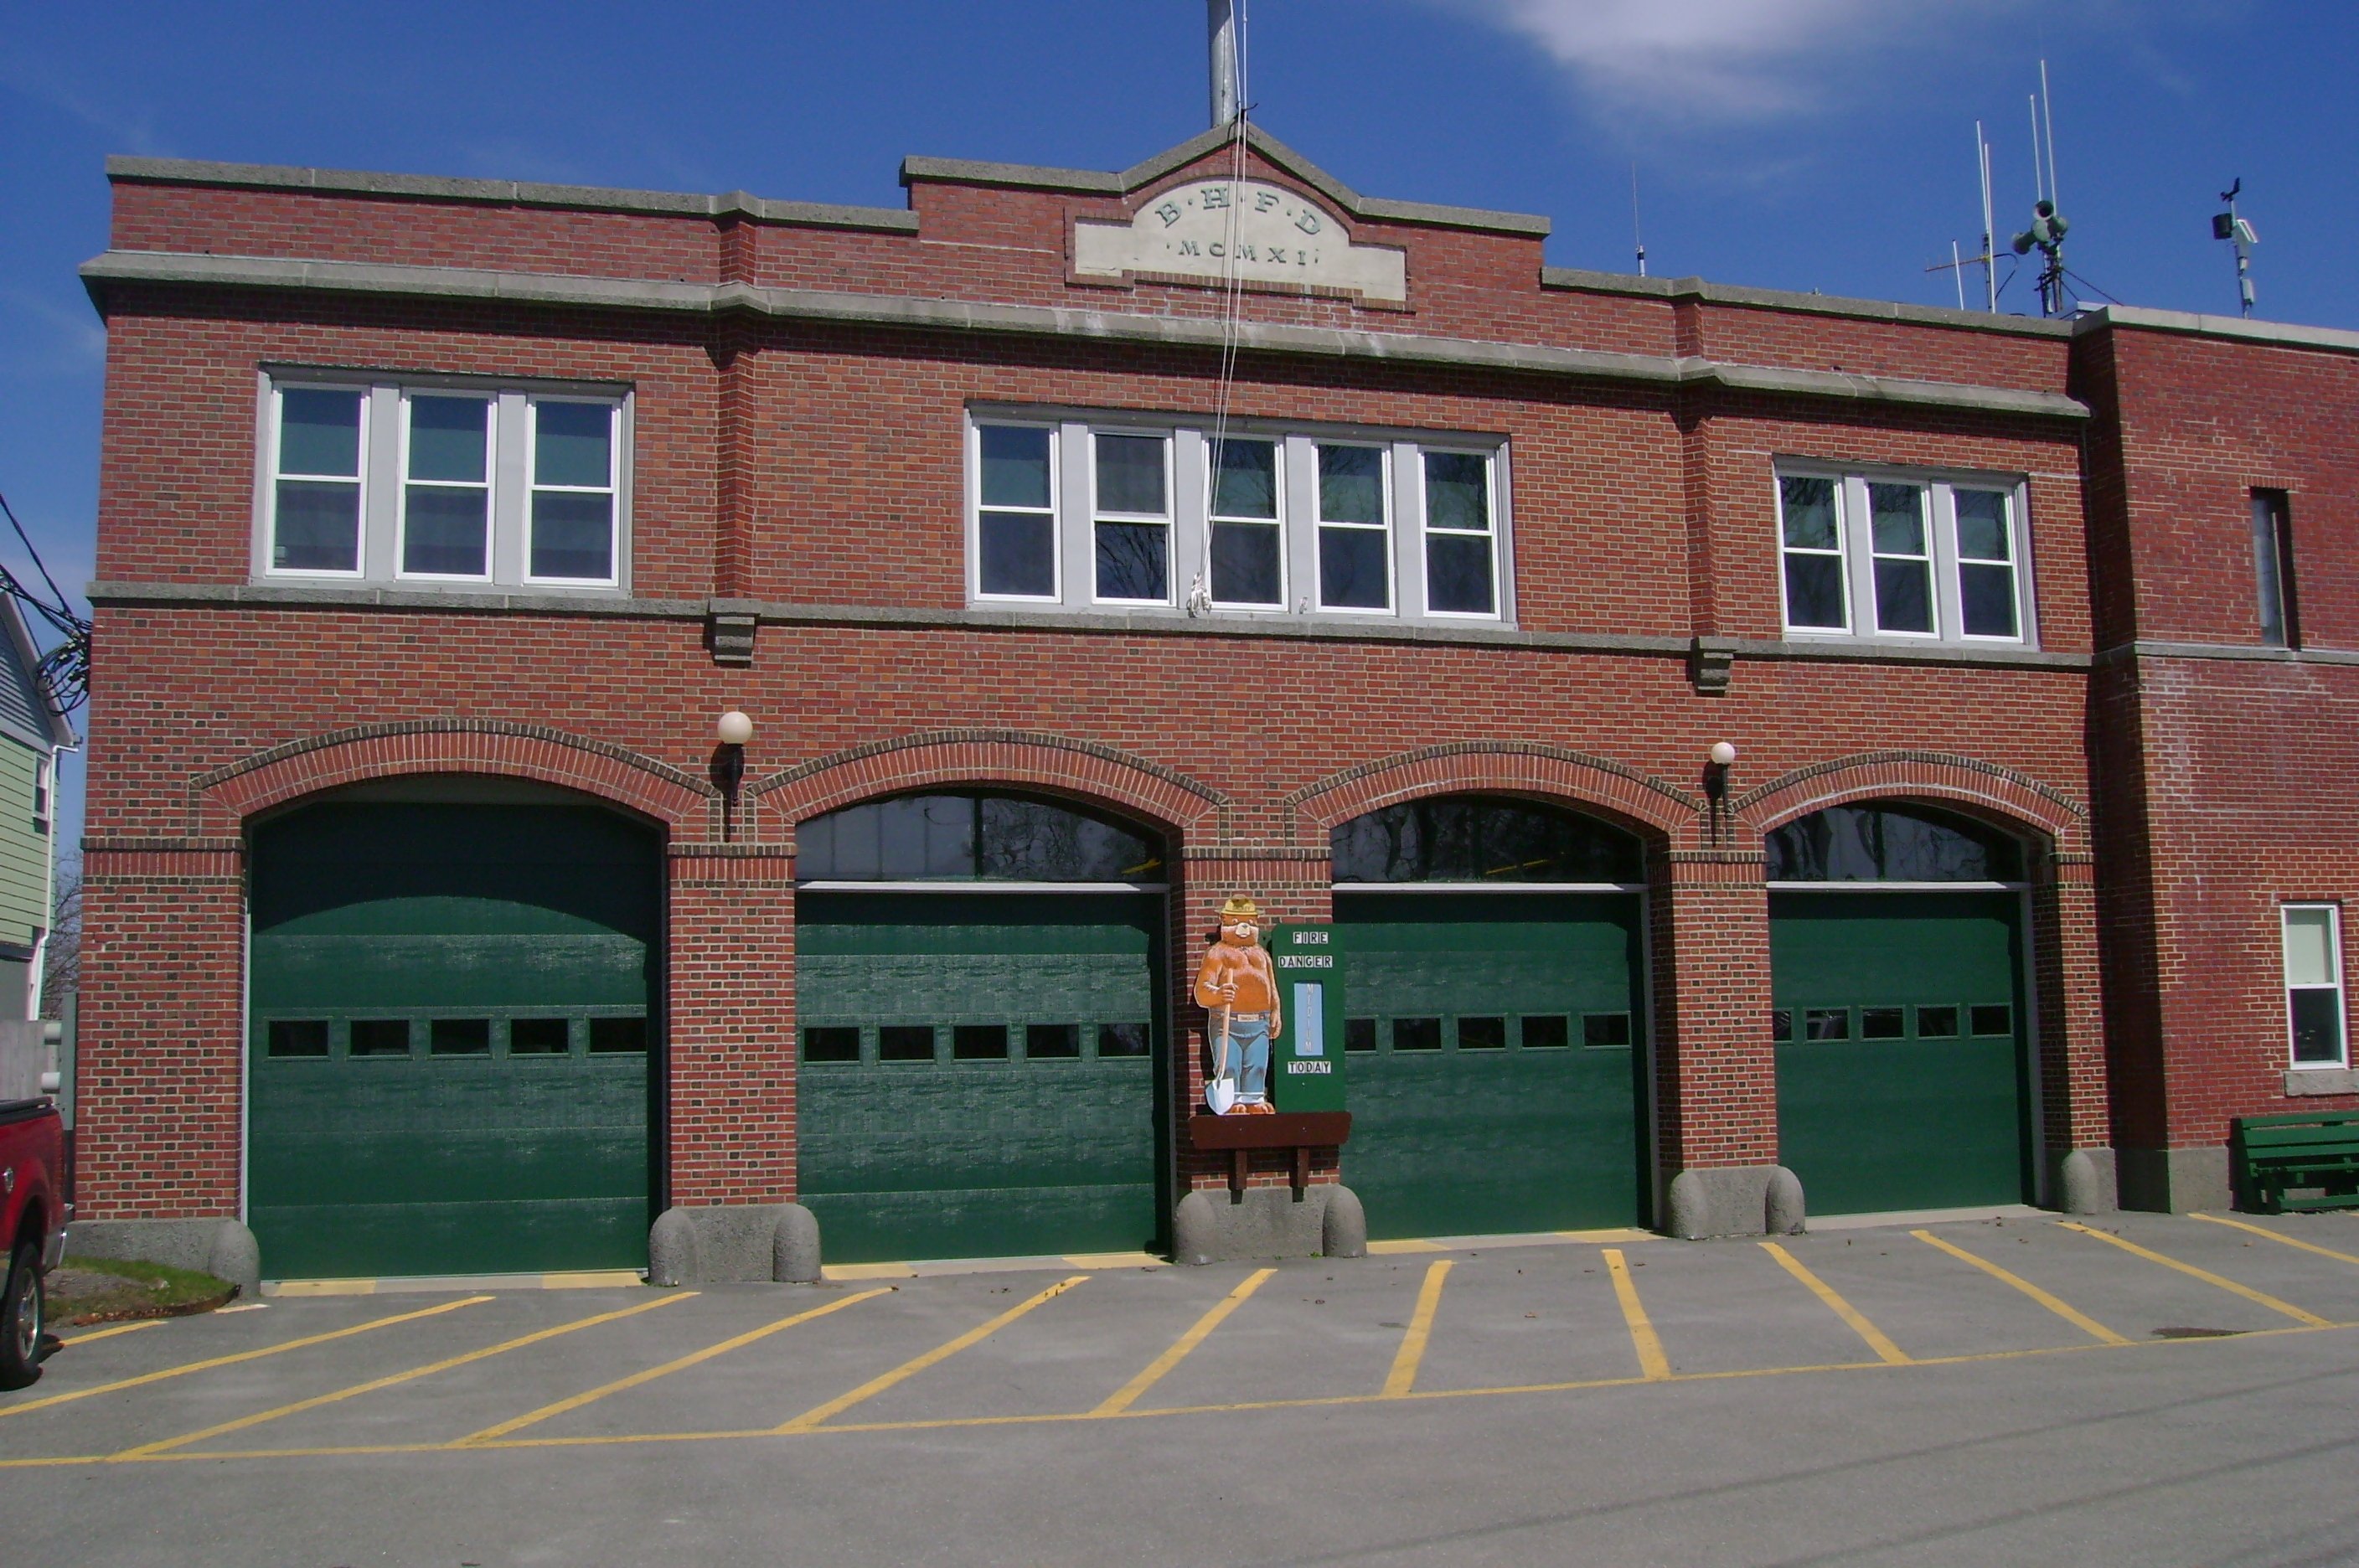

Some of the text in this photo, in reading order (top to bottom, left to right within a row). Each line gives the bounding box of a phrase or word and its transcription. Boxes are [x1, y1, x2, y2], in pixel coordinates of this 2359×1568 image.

[1293, 932, 1328, 944] FIRE
[1278, 956, 1332, 967] DANGER
[1289, 1061, 1330, 1074] TODAY
